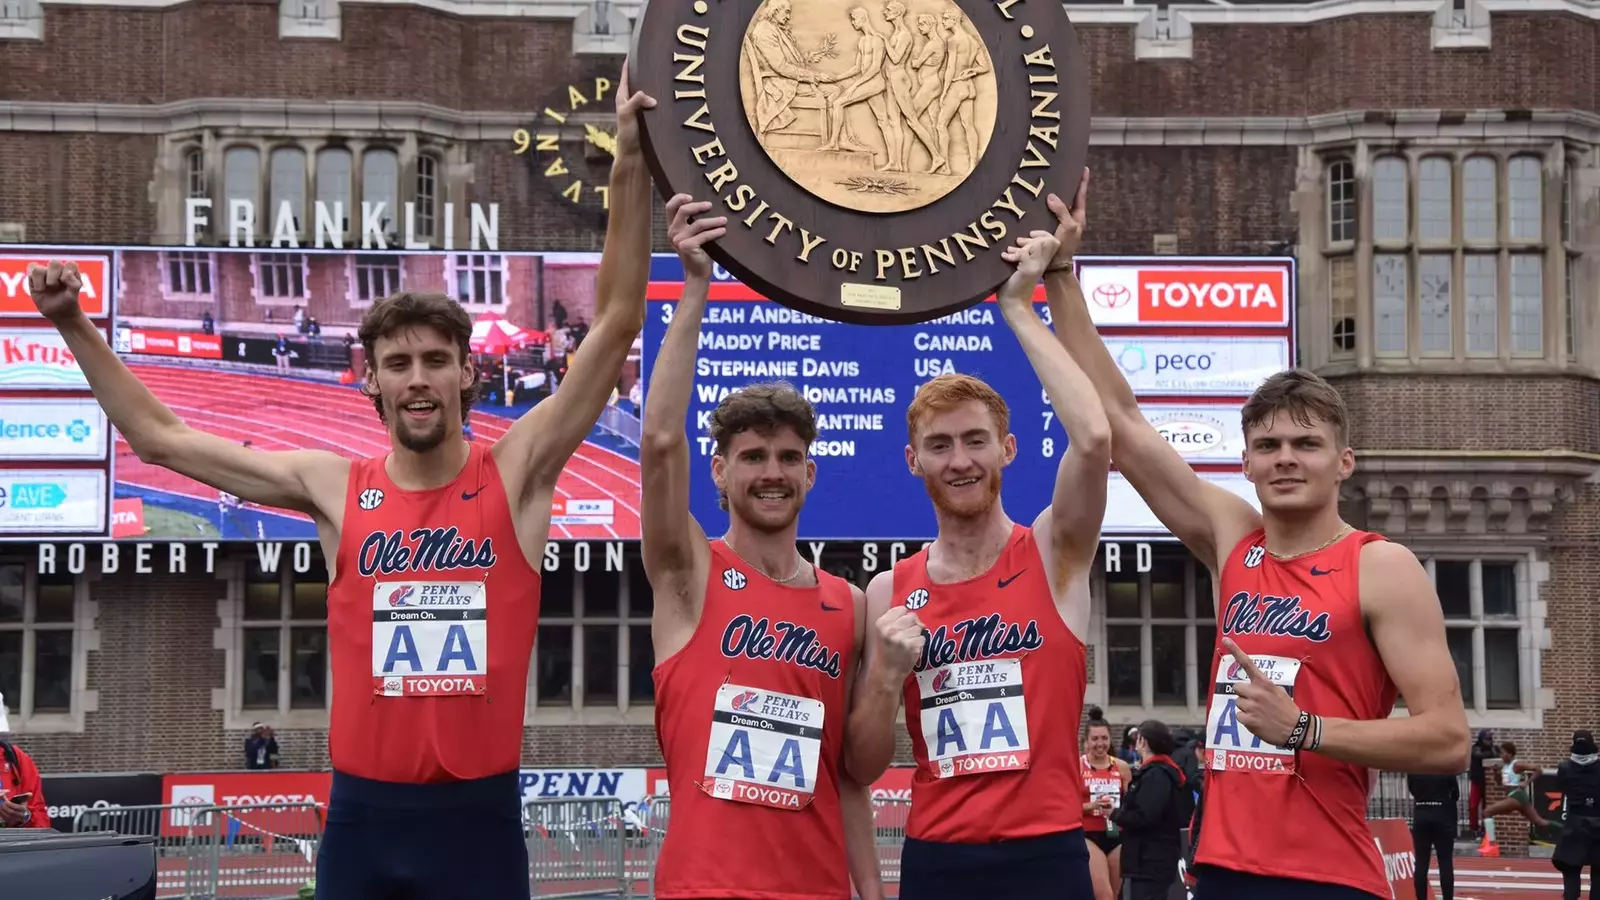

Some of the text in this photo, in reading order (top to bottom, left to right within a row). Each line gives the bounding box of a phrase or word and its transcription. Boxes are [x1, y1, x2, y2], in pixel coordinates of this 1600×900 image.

[512, 128, 531, 155] 9
[673, 23, 1061, 280] UNIVERSITY OF PENNSYLVANIA
[184, 197, 499, 251] FRANKLIN
[1144, 282, 1278, 308] TOYOTA
[661, 303, 674, 324] 3
[697, 331, 993, 352] MADDY PRICE CANADA
[696, 358, 957, 377] STEPHANIE DAVIS USA
[1155, 353, 1212, 374] peco
[1041, 411, 1053, 431] 7
[1042, 438, 1054, 458] 8
[15, 485, 53, 506] AVE
[359, 488, 385, 510] SEC
[38, 542, 219, 574] ROBERT
[358, 525, 497, 577] Ole Miss
[723, 567, 748, 590] SEC
[418, 595, 472, 606] RELAYS
[421, 585, 460, 595] PENN
[906, 588, 930, 610] SEC
[390, 611, 437, 621] Dream On.
[1222, 590, 1331, 643] Ole Miss
[720, 613, 842, 679] Ole Miss
[953, 612, 1044, 662] Miss
[382, 624, 478, 673] A A
[956, 672, 1009, 687] RELAYS
[957, 663, 996, 677] PENN
[406, 678, 476, 693] TOYOTA
[763, 694, 802, 710] PENN
[935, 690, 975, 706] Dream On.
[730, 714, 775, 731] Dream On.
[760, 703, 811, 722] RELAYS
[936, 702, 1020, 757] A A
[714, 728, 807, 789] A A
[956, 755, 1020, 772] TOYOTA
[1227, 753, 1286, 772] TOYOTA
[519, 772, 624, 797] PENN
[221, 793, 318, 813] TOYOTA
[737, 783, 801, 808] TOYOTA
